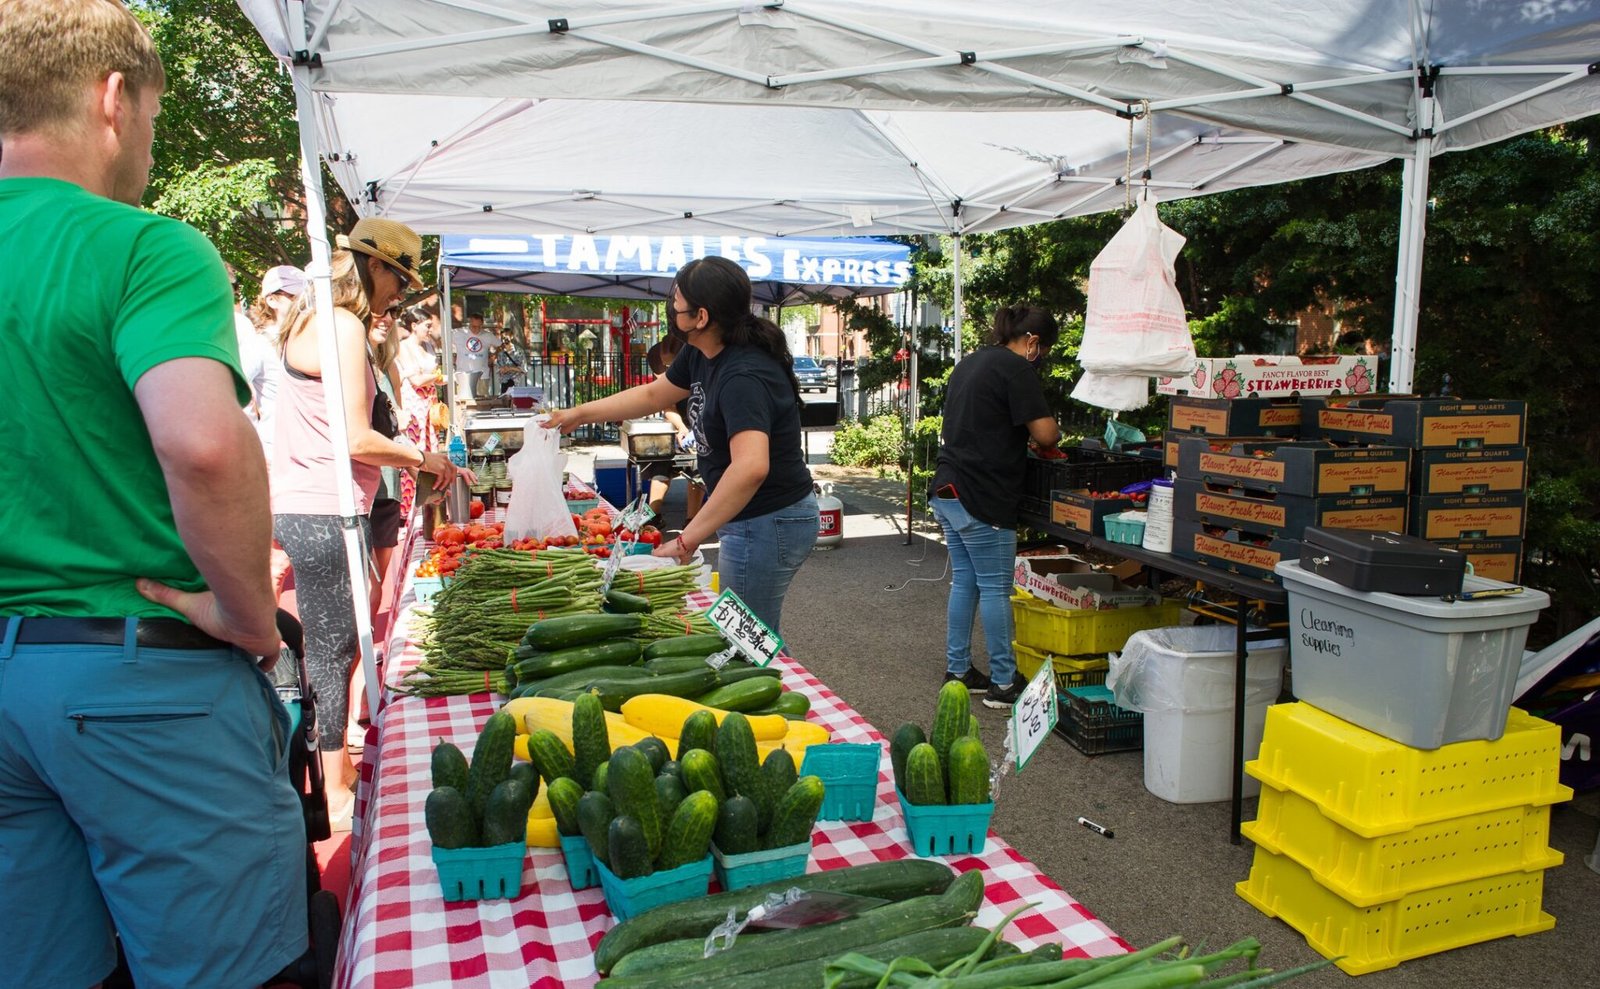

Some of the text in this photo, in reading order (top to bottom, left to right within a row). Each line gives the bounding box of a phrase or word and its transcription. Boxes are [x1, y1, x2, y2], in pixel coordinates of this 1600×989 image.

[1286, 370, 1313, 378] FLAVOR
[1314, 369, 1329, 377] BEST
[1247, 378, 1342, 392] STRAWBERRIES
[1366, 415, 1390, 429] Fruits
[1486, 421, 1511, 429] Fruits
[1253, 461, 1279, 477] Fruits
[1375, 466, 1397, 474] Fruits
[1490, 466, 1514, 474] Fruits
[1254, 505, 1282, 521] Fruits
[1489, 513, 1512, 521] Fruits
[1246, 550, 1275, 567] Fruits
[1029, 577, 1079, 607] STRAWBERRIES
[1301, 608, 1355, 647] Cleaning
